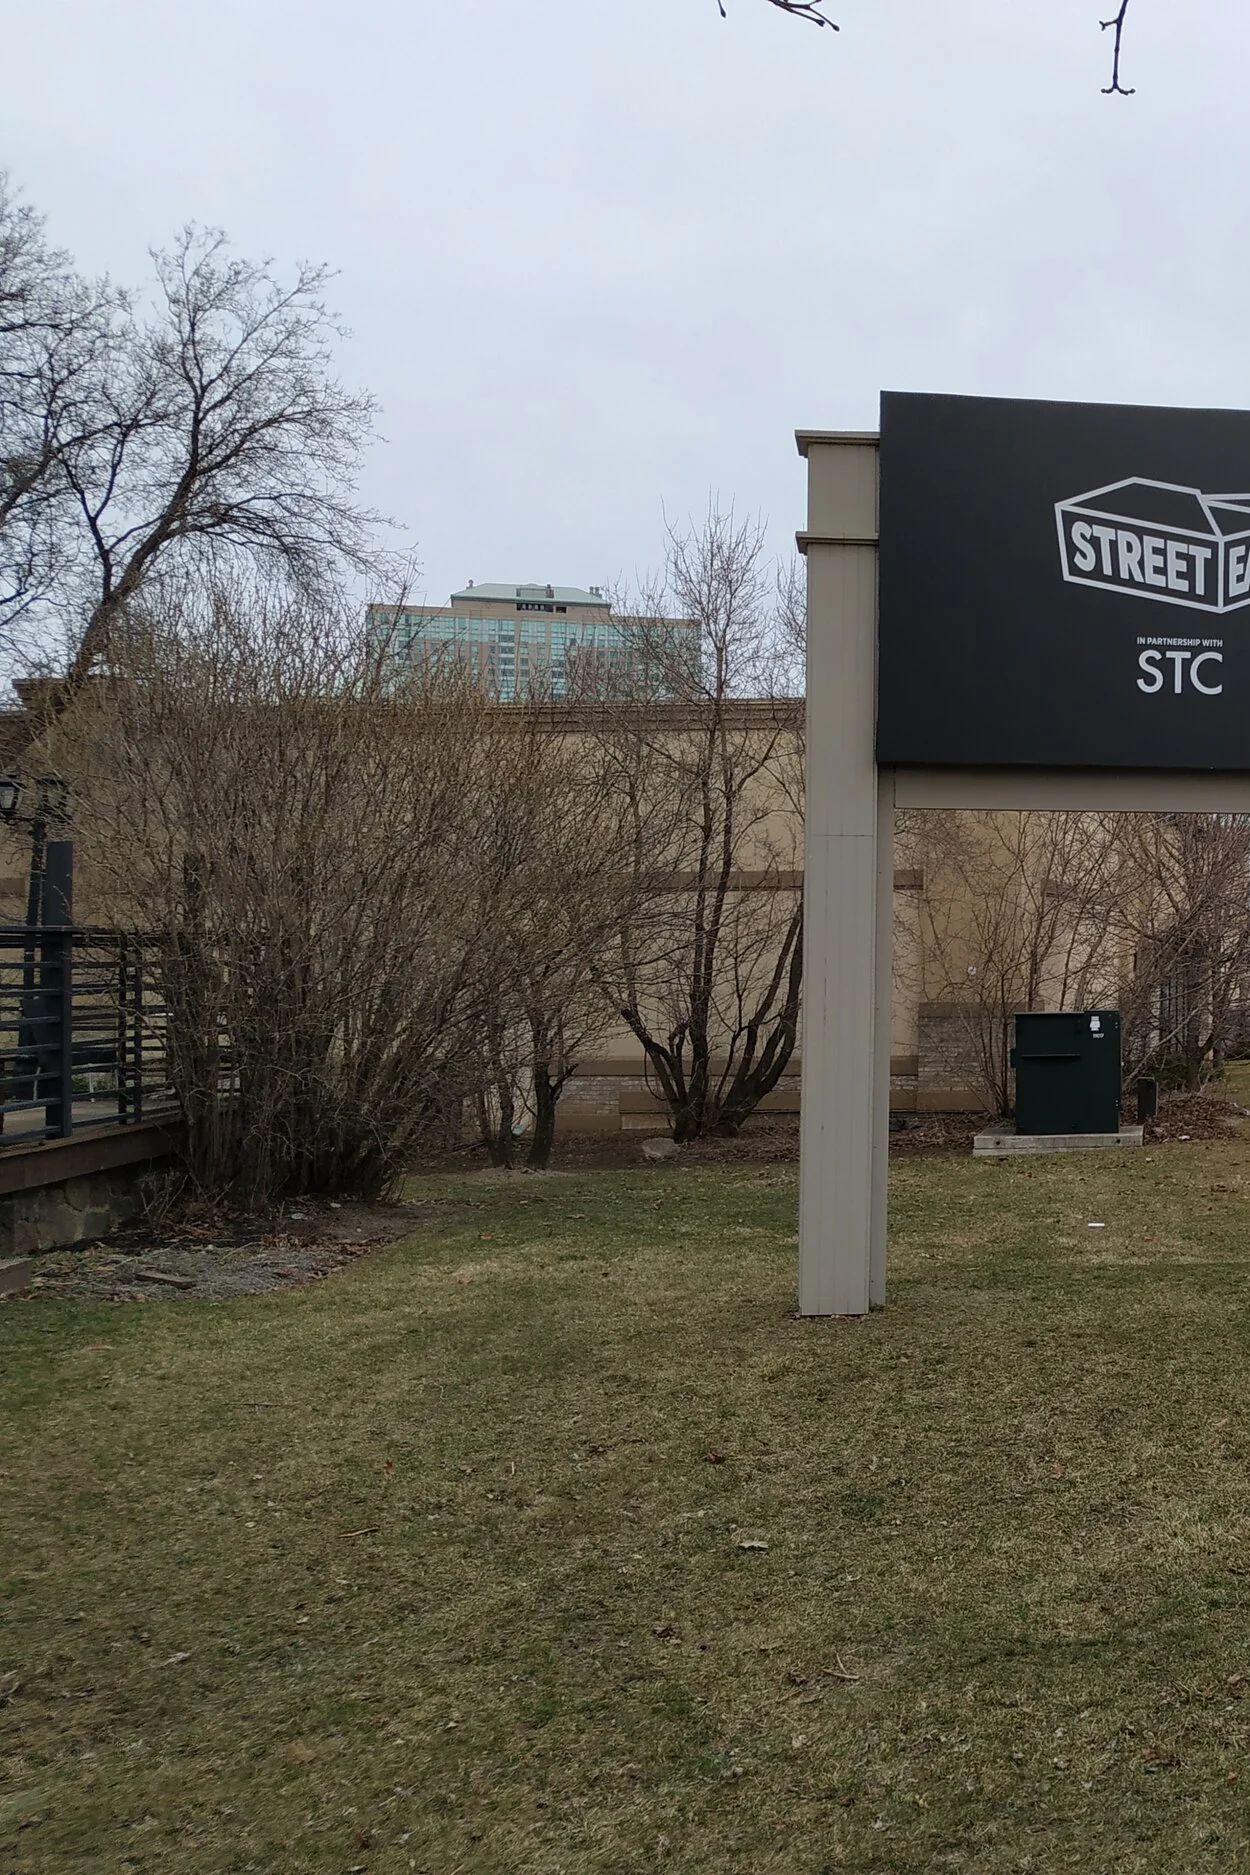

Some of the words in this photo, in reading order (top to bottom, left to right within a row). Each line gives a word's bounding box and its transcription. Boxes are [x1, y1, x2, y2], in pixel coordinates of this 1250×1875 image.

[1071, 521, 1212, 596] STREET
[1136, 636, 1146, 645] IN
[1147, 637, 1201, 647] PARTNERSHIP
[1202, 639, 1223, 648] WITH
[1136, 649, 1223, 695] STC
